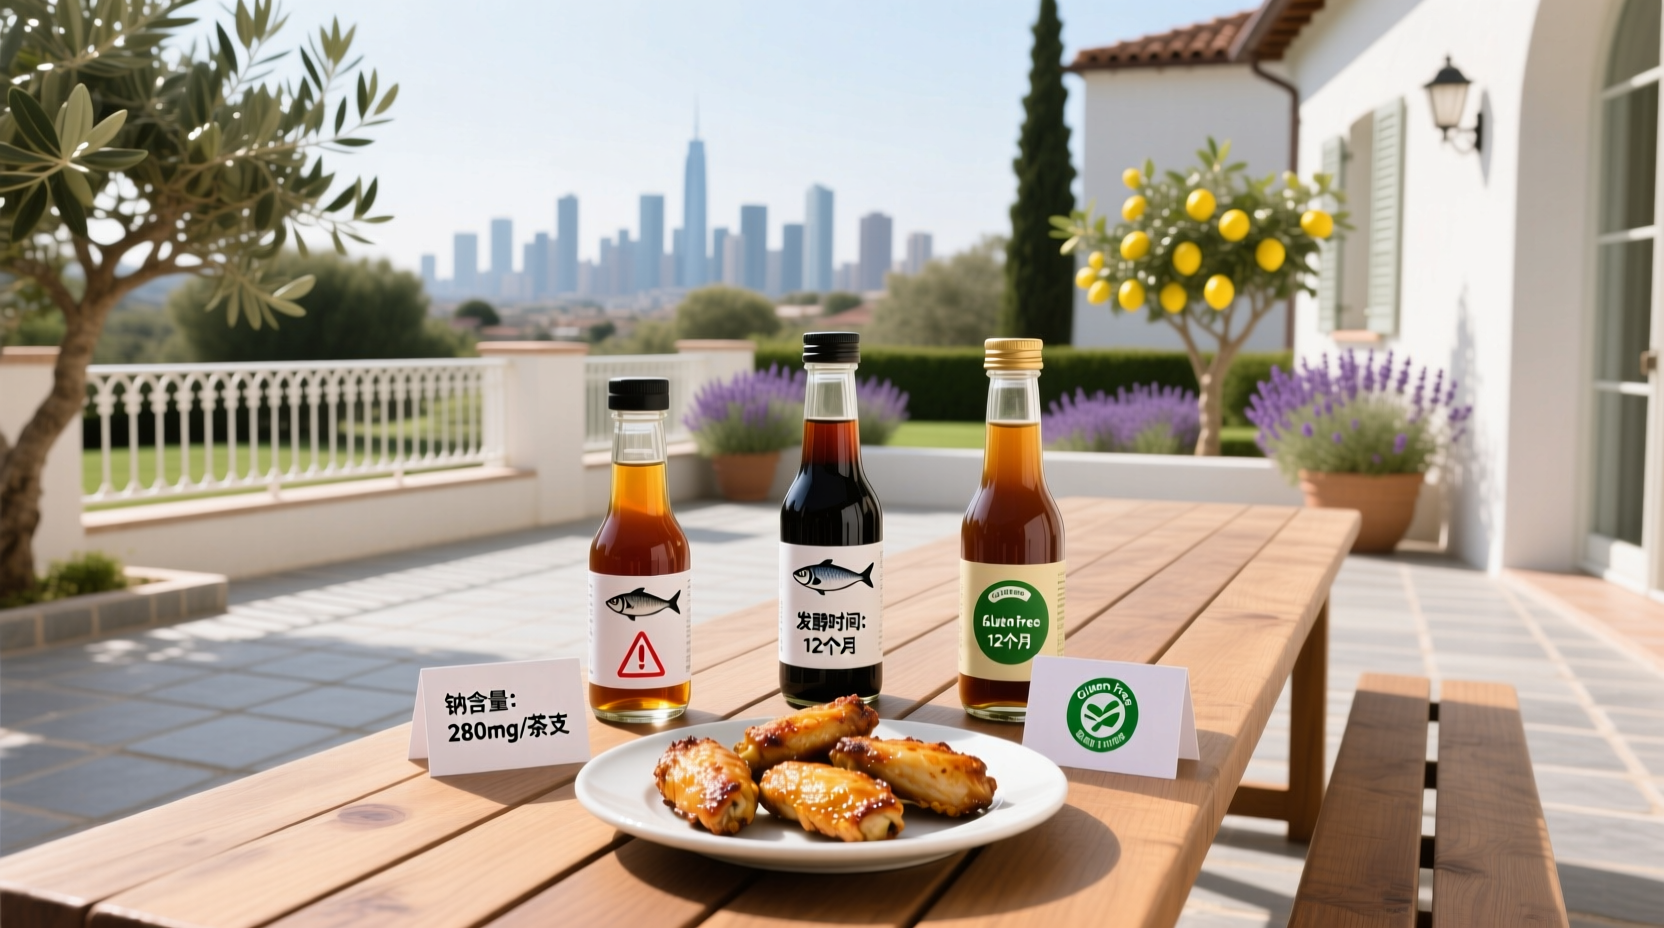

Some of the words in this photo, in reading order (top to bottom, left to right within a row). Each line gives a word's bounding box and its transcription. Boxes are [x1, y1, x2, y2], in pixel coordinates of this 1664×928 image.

[803, 636, 855, 656] 12个月
[987, 632, 1031, 650] 12个月
[444, 689, 516, 715] 钠含量:
[447, 712, 570, 743] 280mg/茶支
